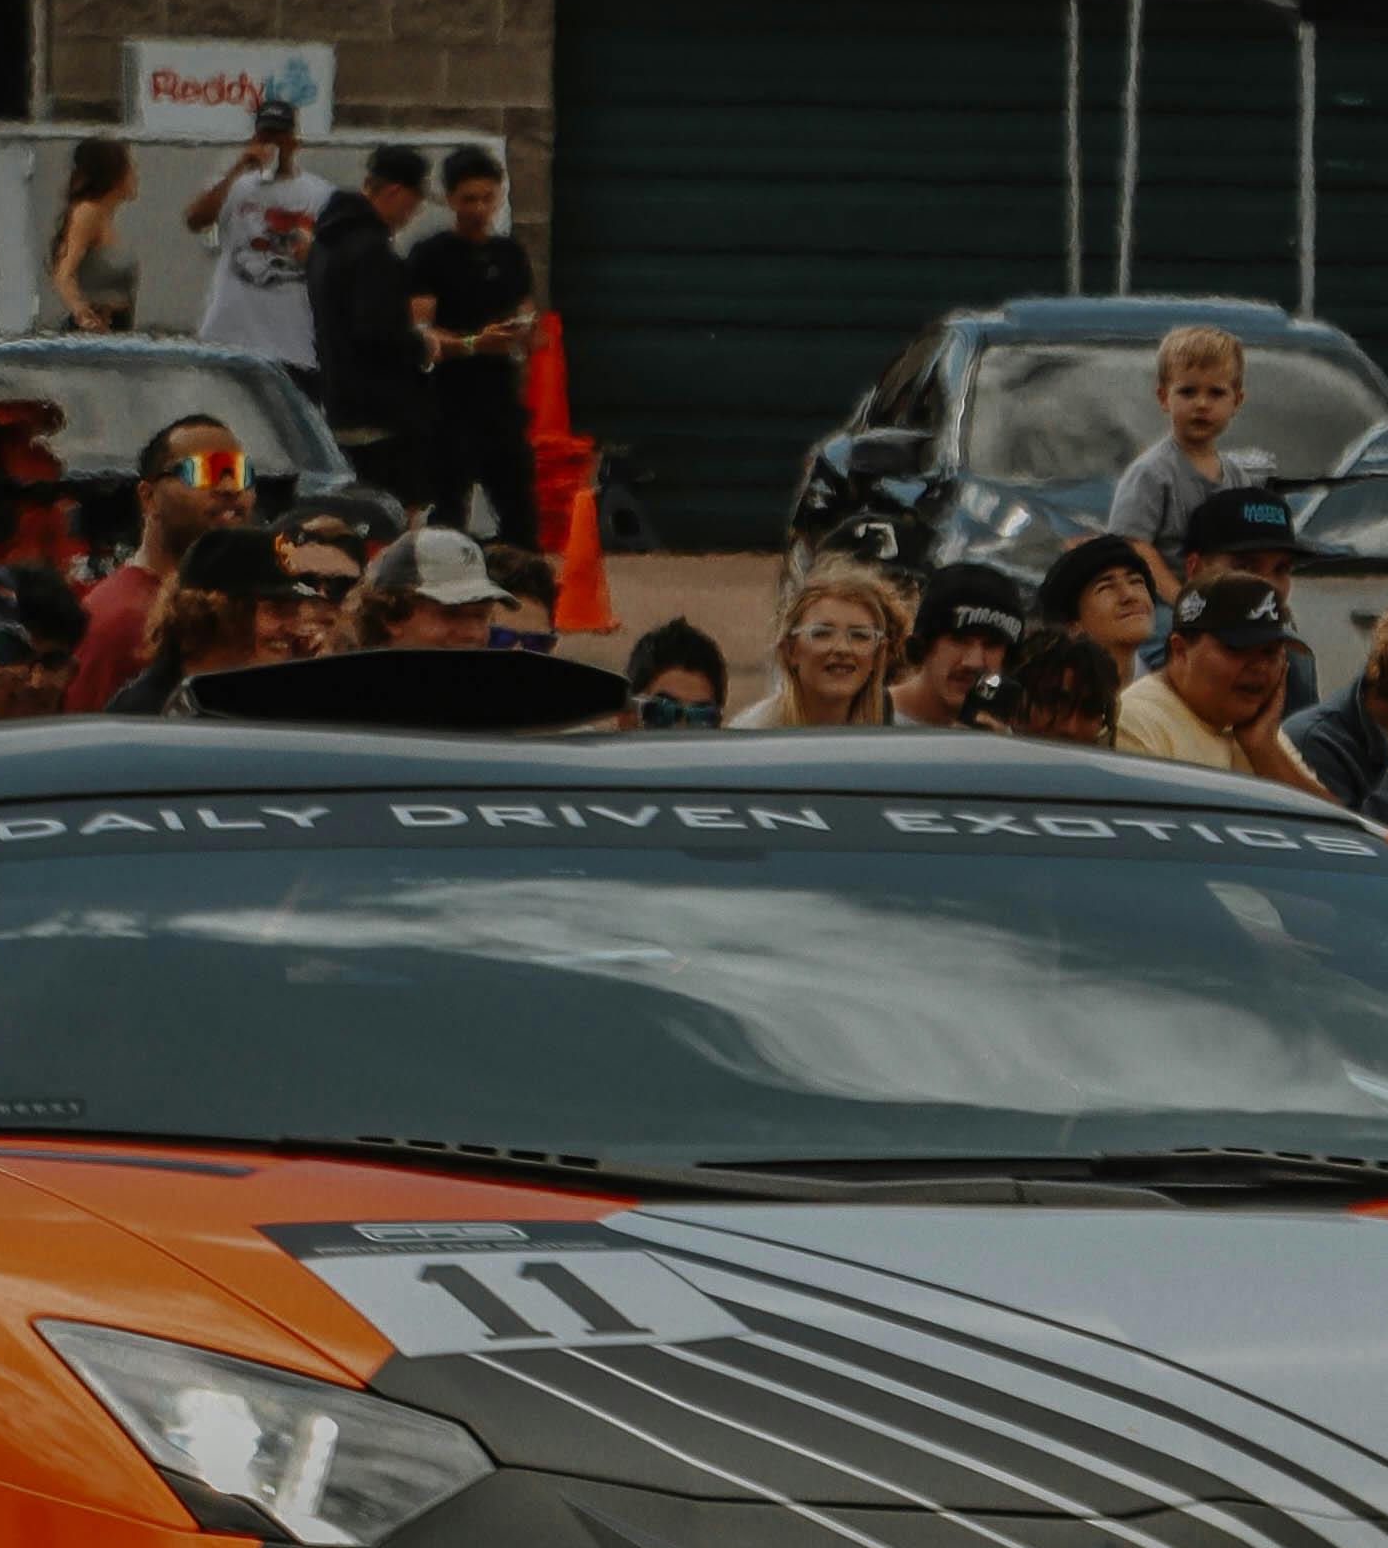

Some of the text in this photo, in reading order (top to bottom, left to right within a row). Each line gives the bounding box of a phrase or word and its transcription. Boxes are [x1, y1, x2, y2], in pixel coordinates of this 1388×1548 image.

[151, 68, 264, 112] Reddy
[390, 803, 827, 830] DRIVEN
[882, 808, 1380, 857] EXOTICS
[418, 1262, 656, 1341] 11
